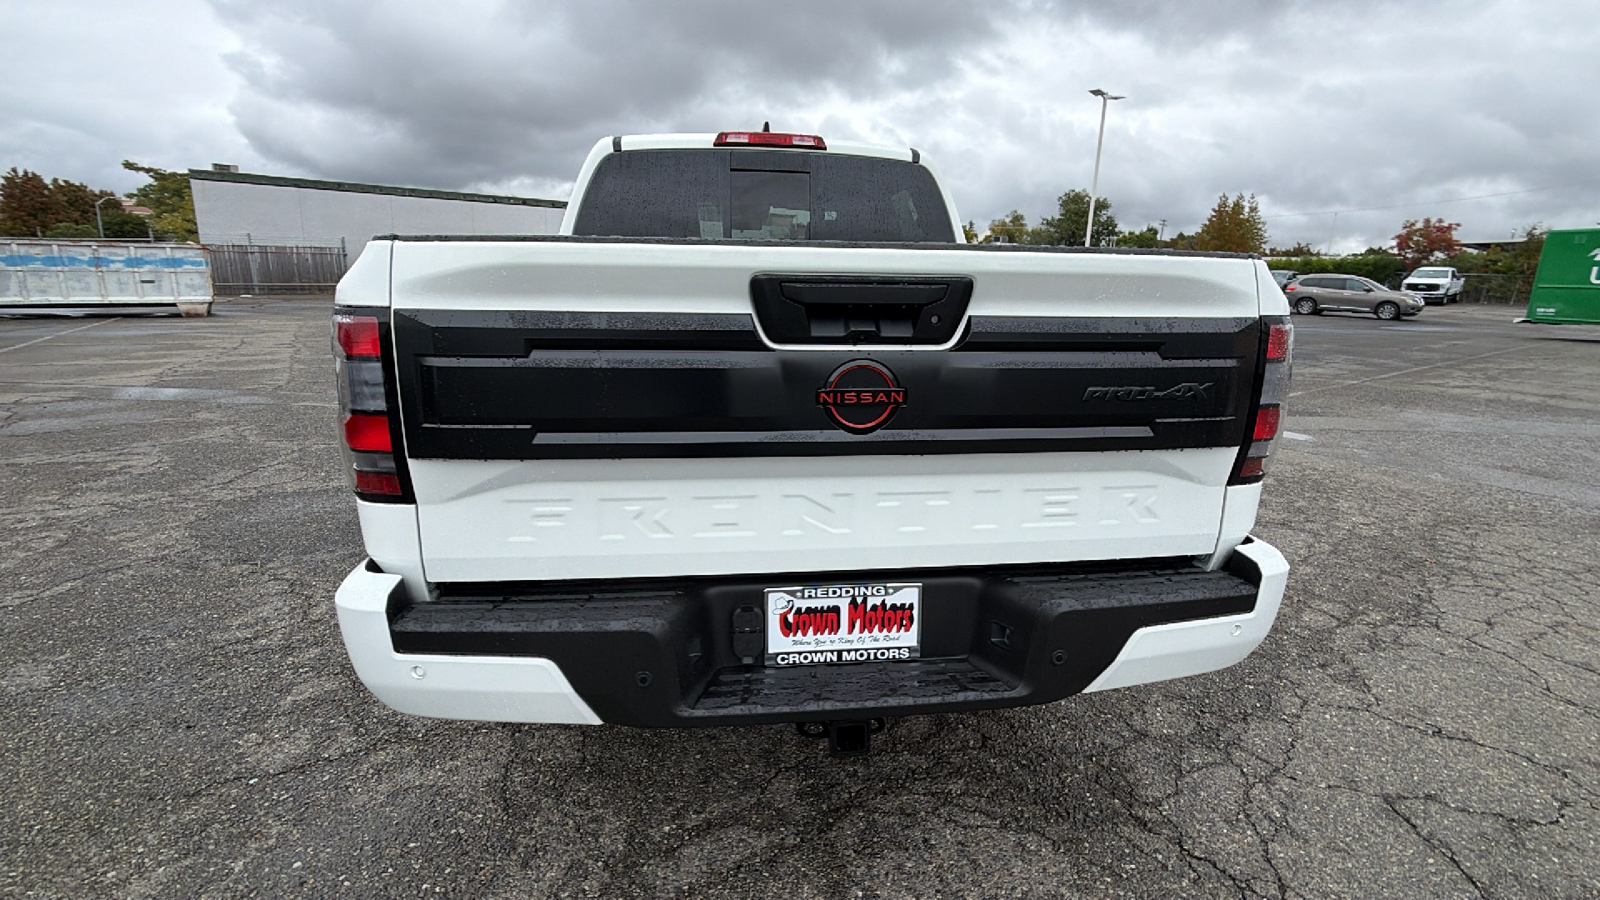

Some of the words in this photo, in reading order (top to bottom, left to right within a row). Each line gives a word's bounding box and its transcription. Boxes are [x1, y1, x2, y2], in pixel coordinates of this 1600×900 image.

[819, 391, 904, 404] NISSAN
[502, 485, 1160, 542] FRONTIER
[804, 586, 886, 598] REDDING
[779, 600, 841, 638] Crown
[847, 597, 914, 635] Motors
[838, 637, 854, 646] King
[856, 636, 866, 645] Of
[868, 635, 881, 643] The
[883, 634, 901, 642] Road
[776, 652, 837, 665] CROWN
[842, 648, 910, 661] MOTORS
